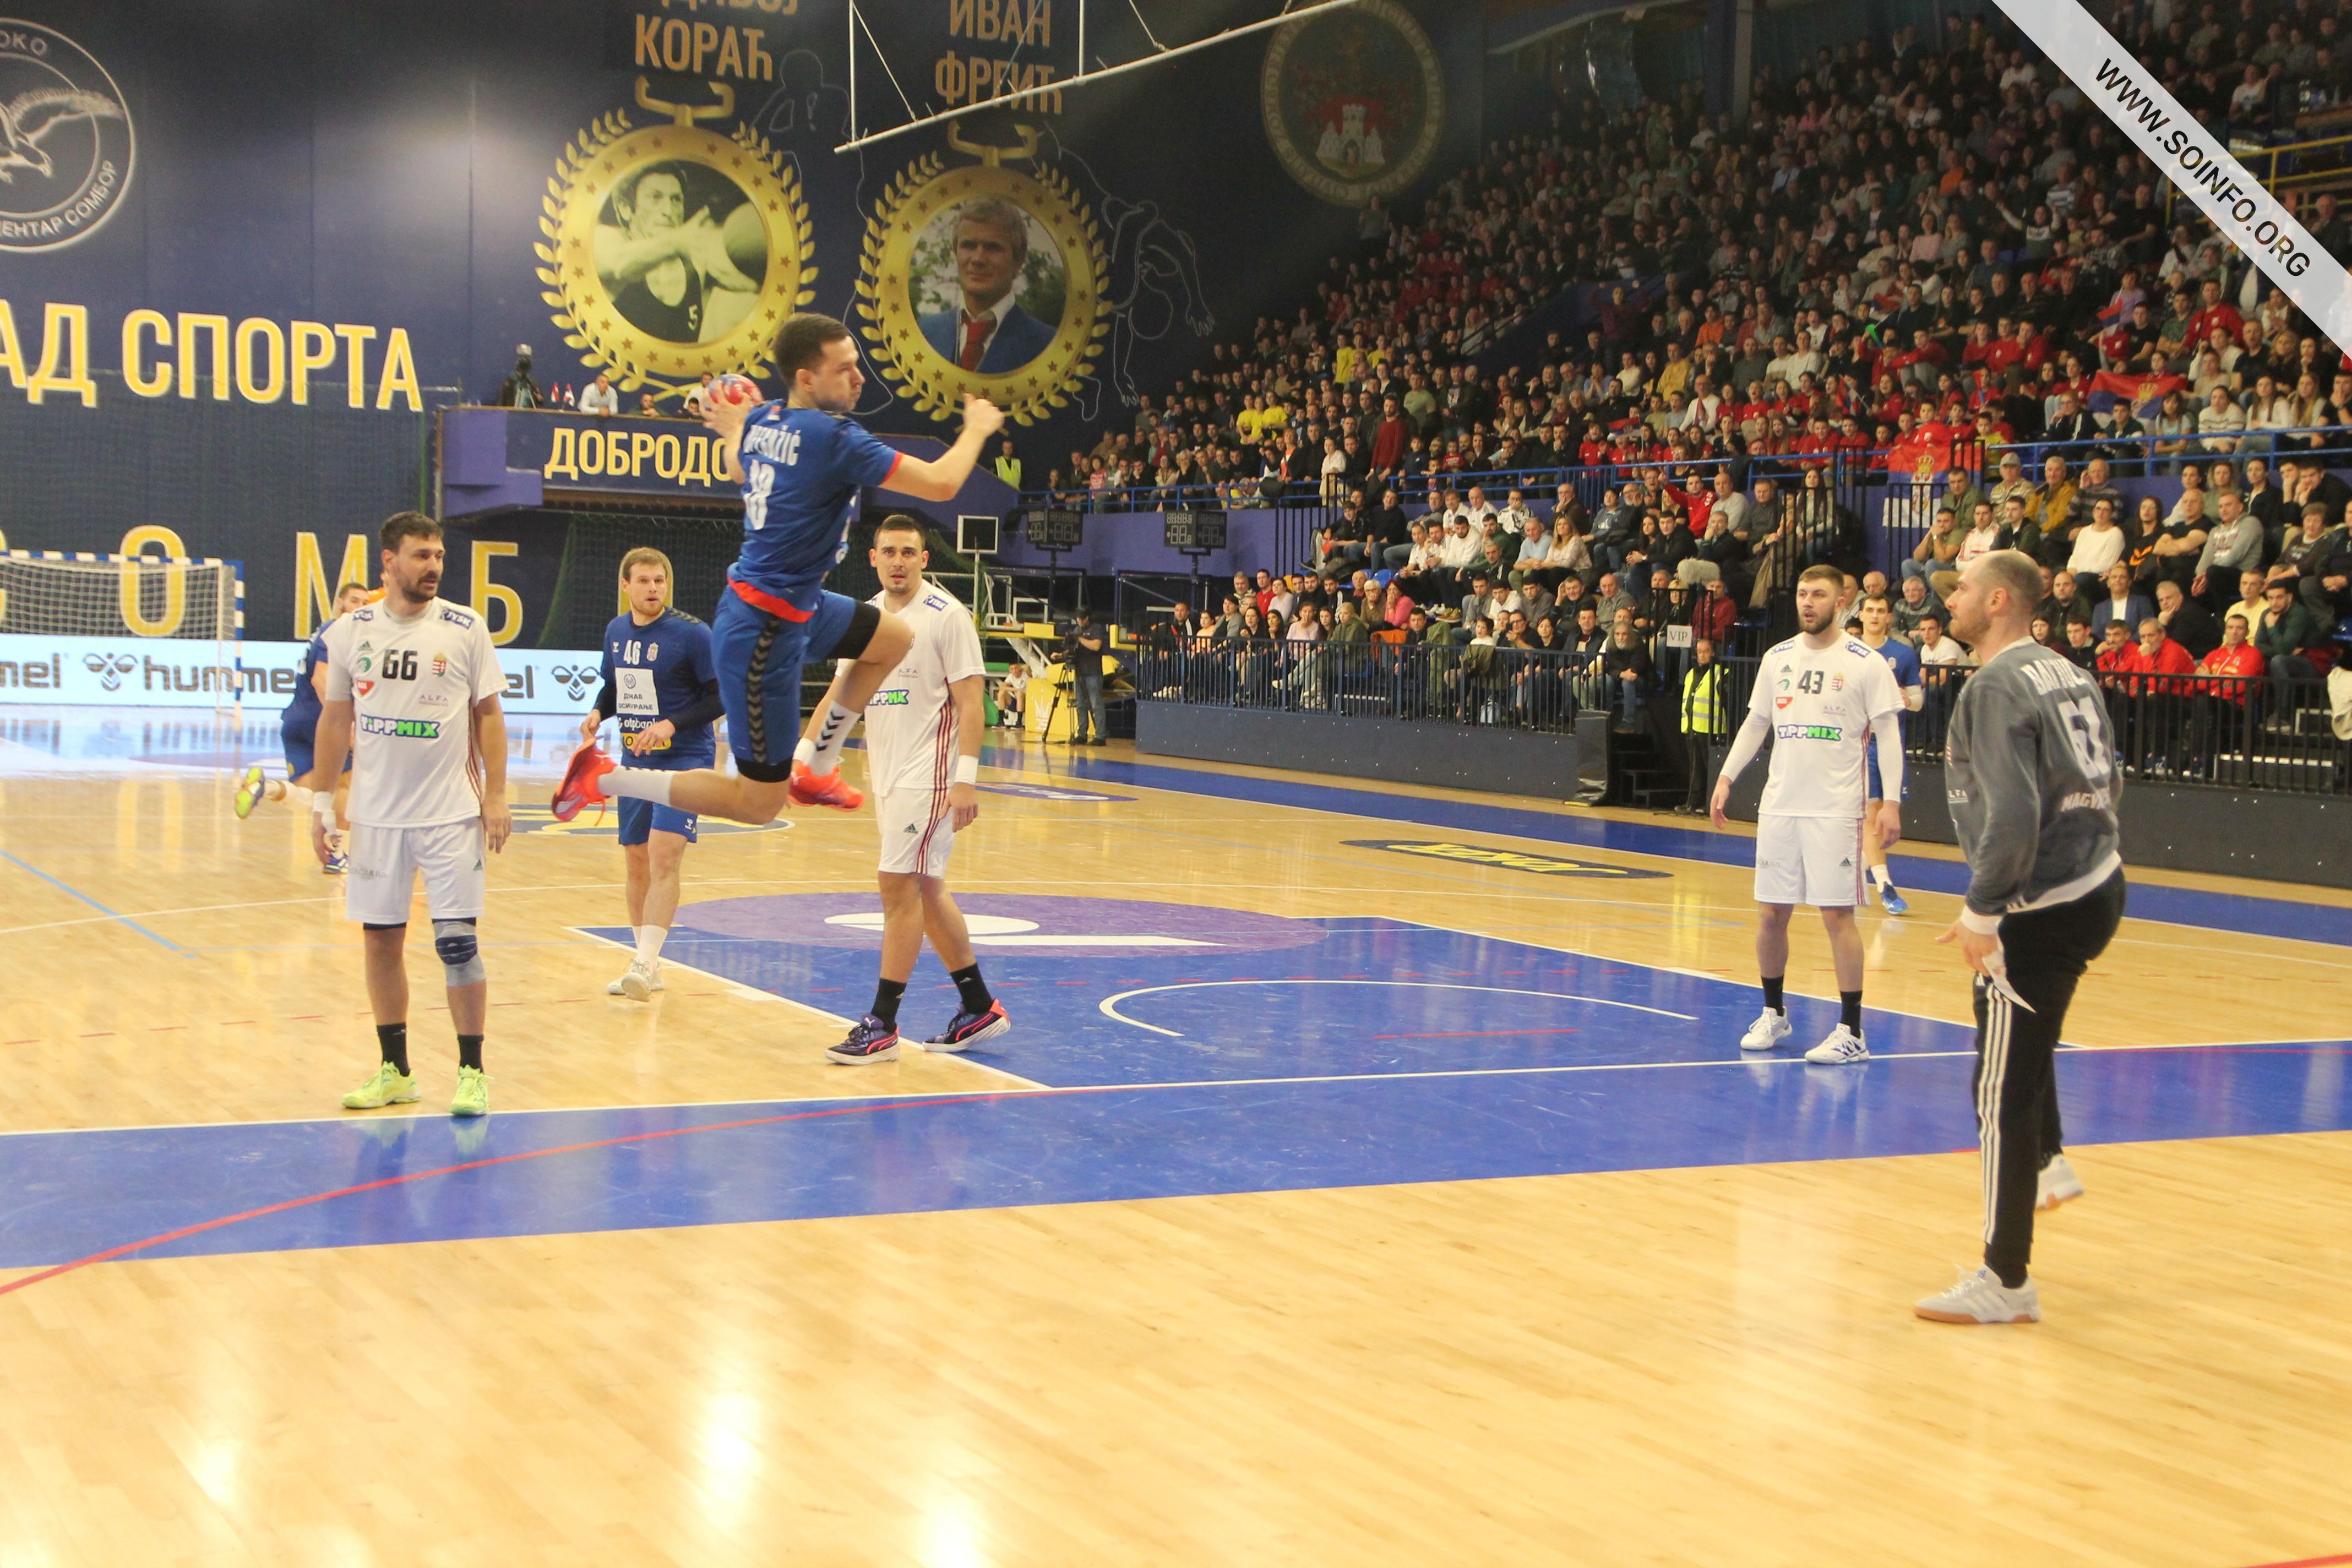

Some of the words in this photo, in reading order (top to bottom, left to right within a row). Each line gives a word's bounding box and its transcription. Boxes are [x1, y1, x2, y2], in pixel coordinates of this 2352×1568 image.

[950, 0, 1051, 48] ИВАН
[635, 14, 773, 82] КОРАЋ
[935, 50, 1063, 115] ФРГИЋ
[0, 216, 66, 238] ЕНТАР
[64, 160, 119, 227] СОМБОР
[687, 304, 699, 331] 5
[0, 299, 97, 409] АД
[122, 308, 424, 412] СПОРТА
[544, 427, 732, 488] ДОБРОДО
[447, 610, 472, 627] JYSK
[623, 639, 642, 666] 46
[1669, 631, 1689, 643] VIP
[144, 655, 297, 693] humme
[382, 649, 418, 680] 66
[1798, 670, 1825, 695] 43
[420, 694, 449, 703] ALFA
[1948, 790, 1968, 798] LFA
